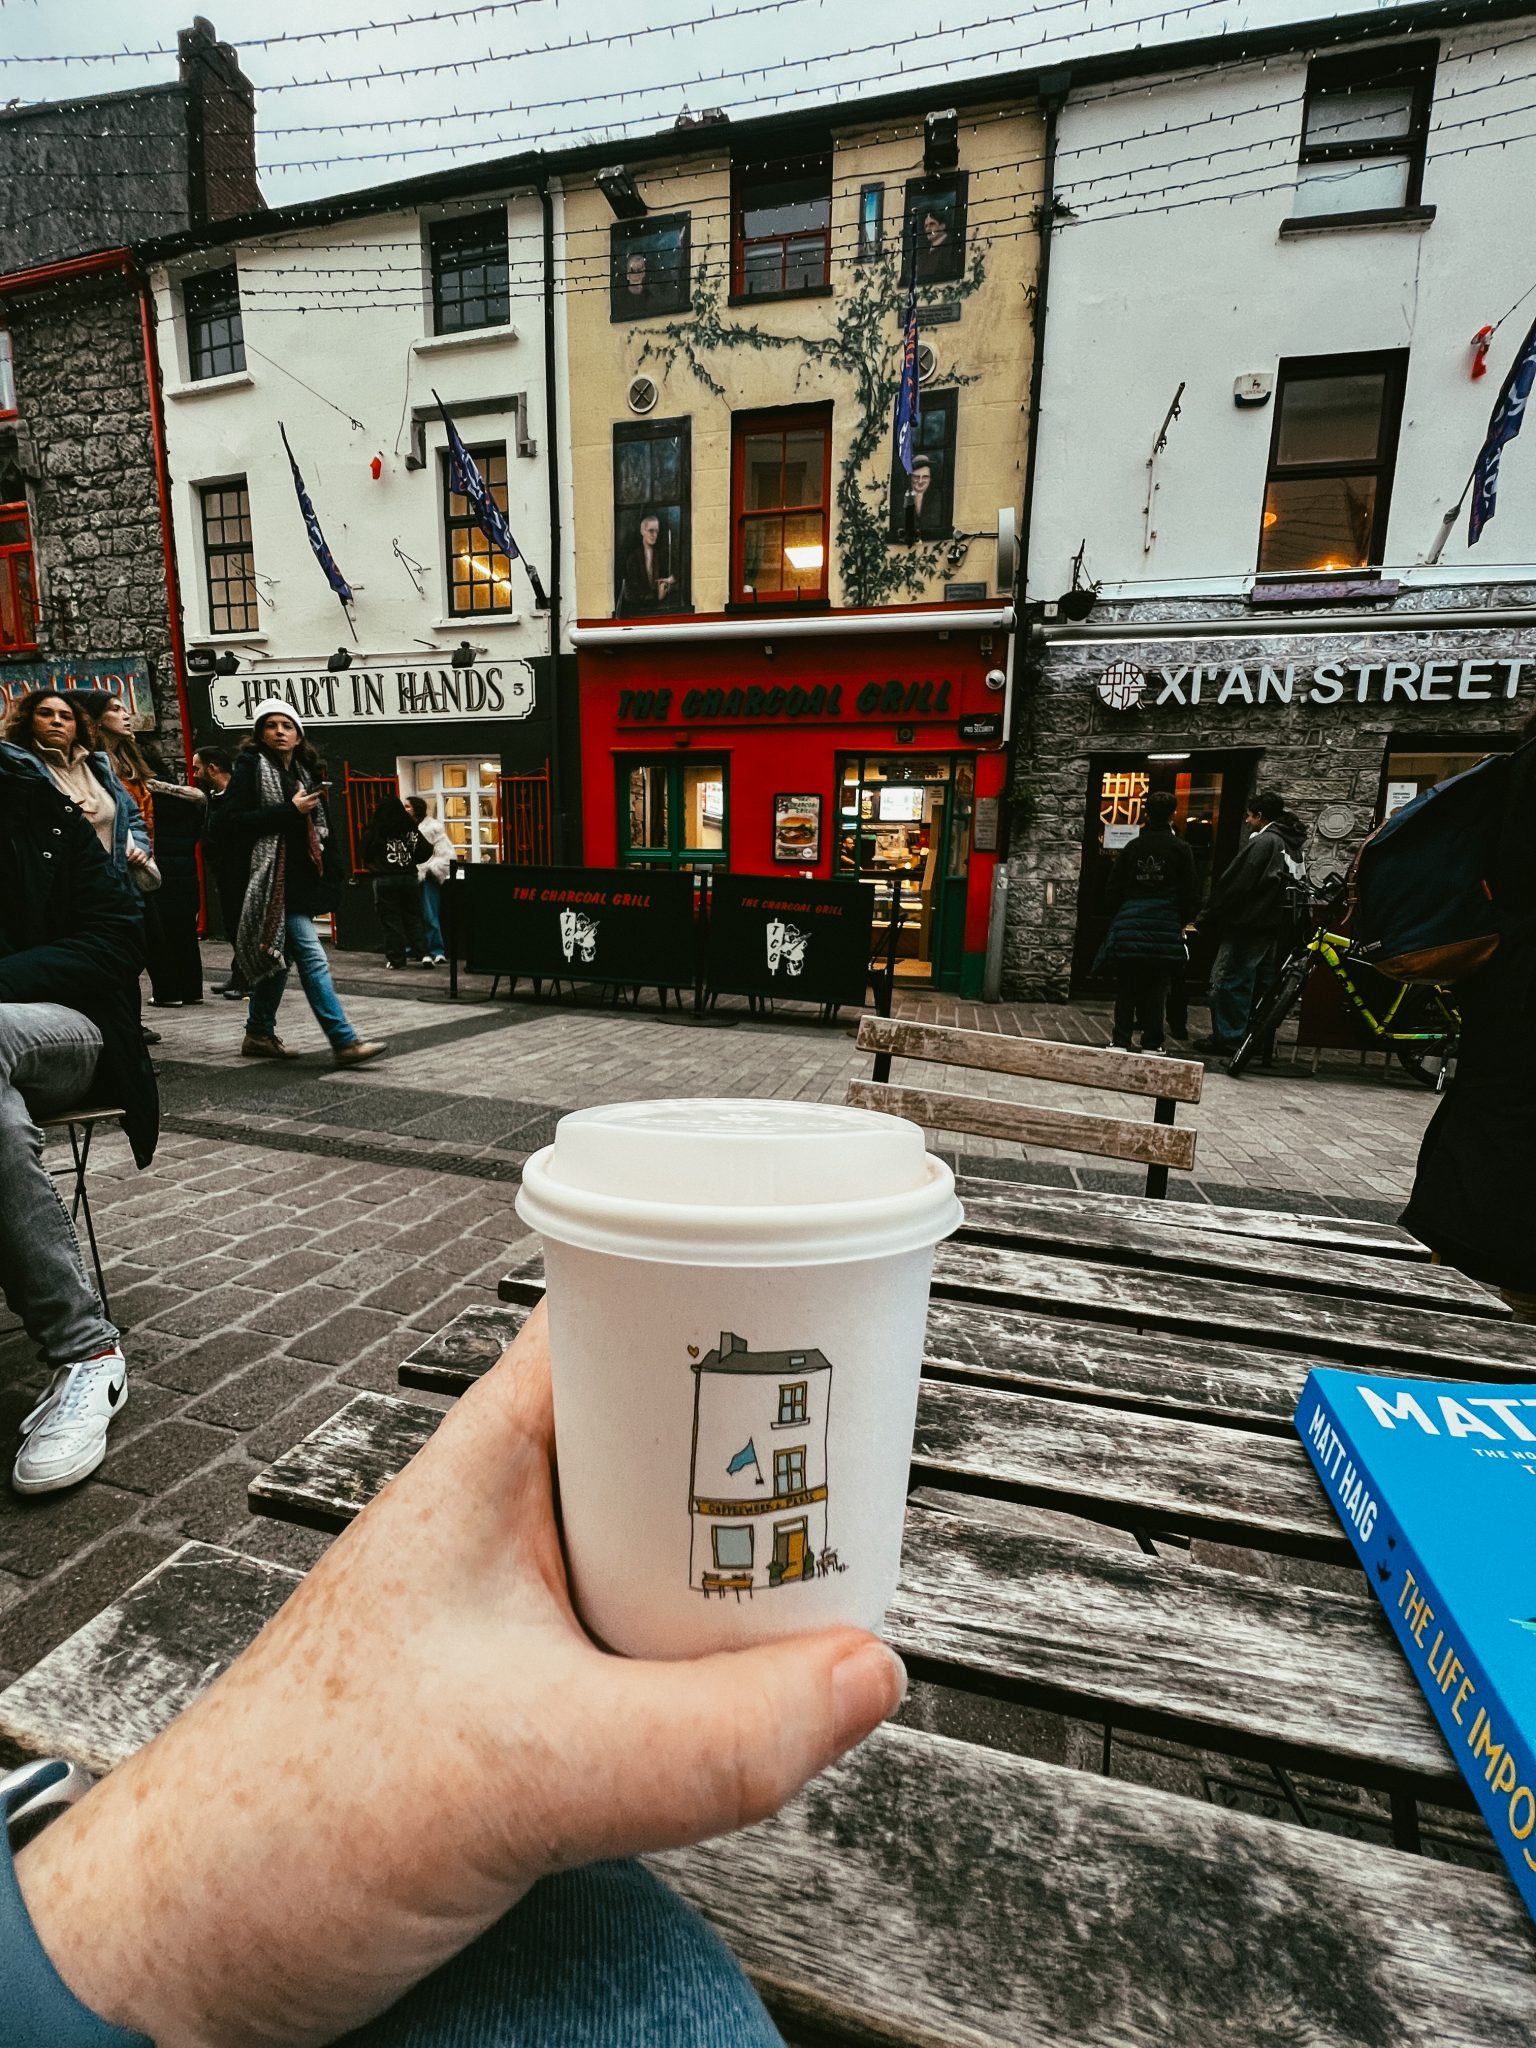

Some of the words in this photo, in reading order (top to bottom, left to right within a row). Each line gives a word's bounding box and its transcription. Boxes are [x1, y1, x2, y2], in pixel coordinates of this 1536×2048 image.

[219, 695, 229, 708] 5
[352, 673, 386, 716] IN
[397, 667, 505, 715] HANDS
[512, 682, 525, 697] 5
[617, 687, 673, 721] THE
[681, 683, 844, 719] CHARCOAL
[855, 679, 953, 714] GRILL
[1156, 663, 1295, 705] XI'AN
[1310, 658, 1536, 704] STREET
[512, 887, 537, 901] THE
[540, 889, 607, 905] CHARCOAL
[612, 893, 651, 908] GRILL
[741, 897, 759, 909] THE
[761, 900, 811, 913] CHARCOAL
[815, 904, 843, 916] GRILL
[1356, 1385, 1536, 1442] MAT
[1308, 1403, 1347, 1481] MATT
[1338, 1460, 1378, 1543] HAIG
[1471, 1448, 1509, 1459] THE
[1398, 1569, 1435, 1649] THE
[1427, 1630, 1476, 1726] LIFE
